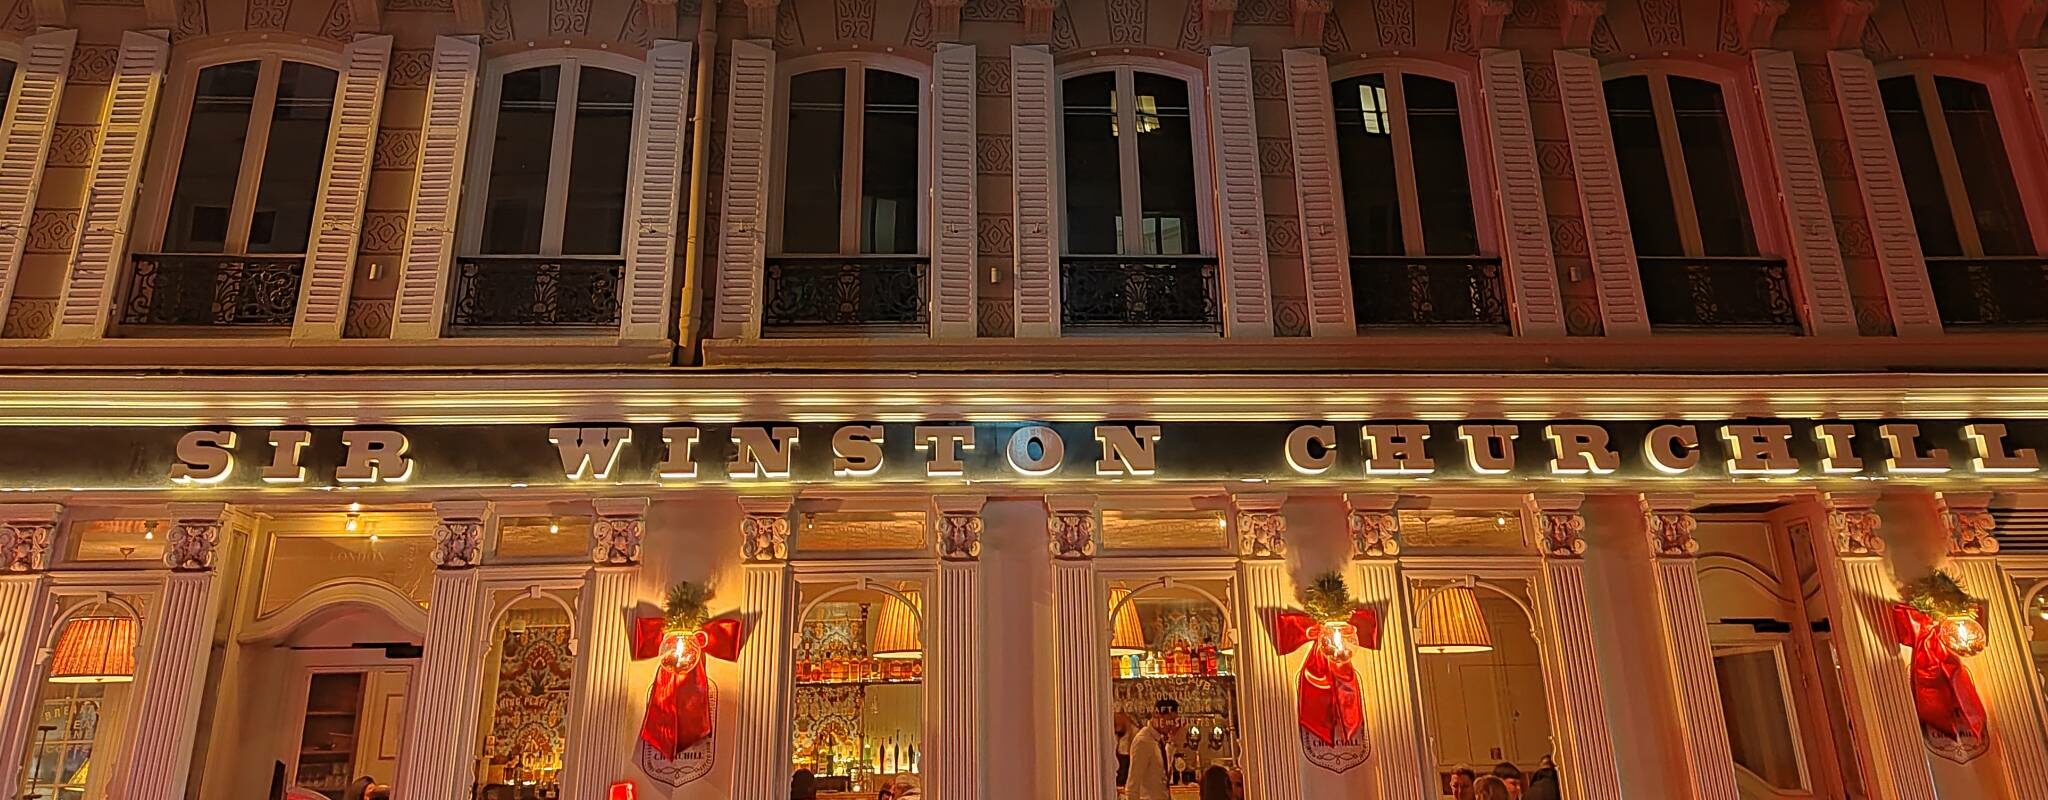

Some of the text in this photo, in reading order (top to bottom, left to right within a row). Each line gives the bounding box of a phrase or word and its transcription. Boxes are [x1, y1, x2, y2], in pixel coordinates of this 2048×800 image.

[170, 424, 2041, 483] SIR WINSTON CHURCHILL
[329, 551, 385, 563] LONDON
[1313, 739, 1359, 747] CHCHILL
[654, 751, 704, 761] CHCHILL
